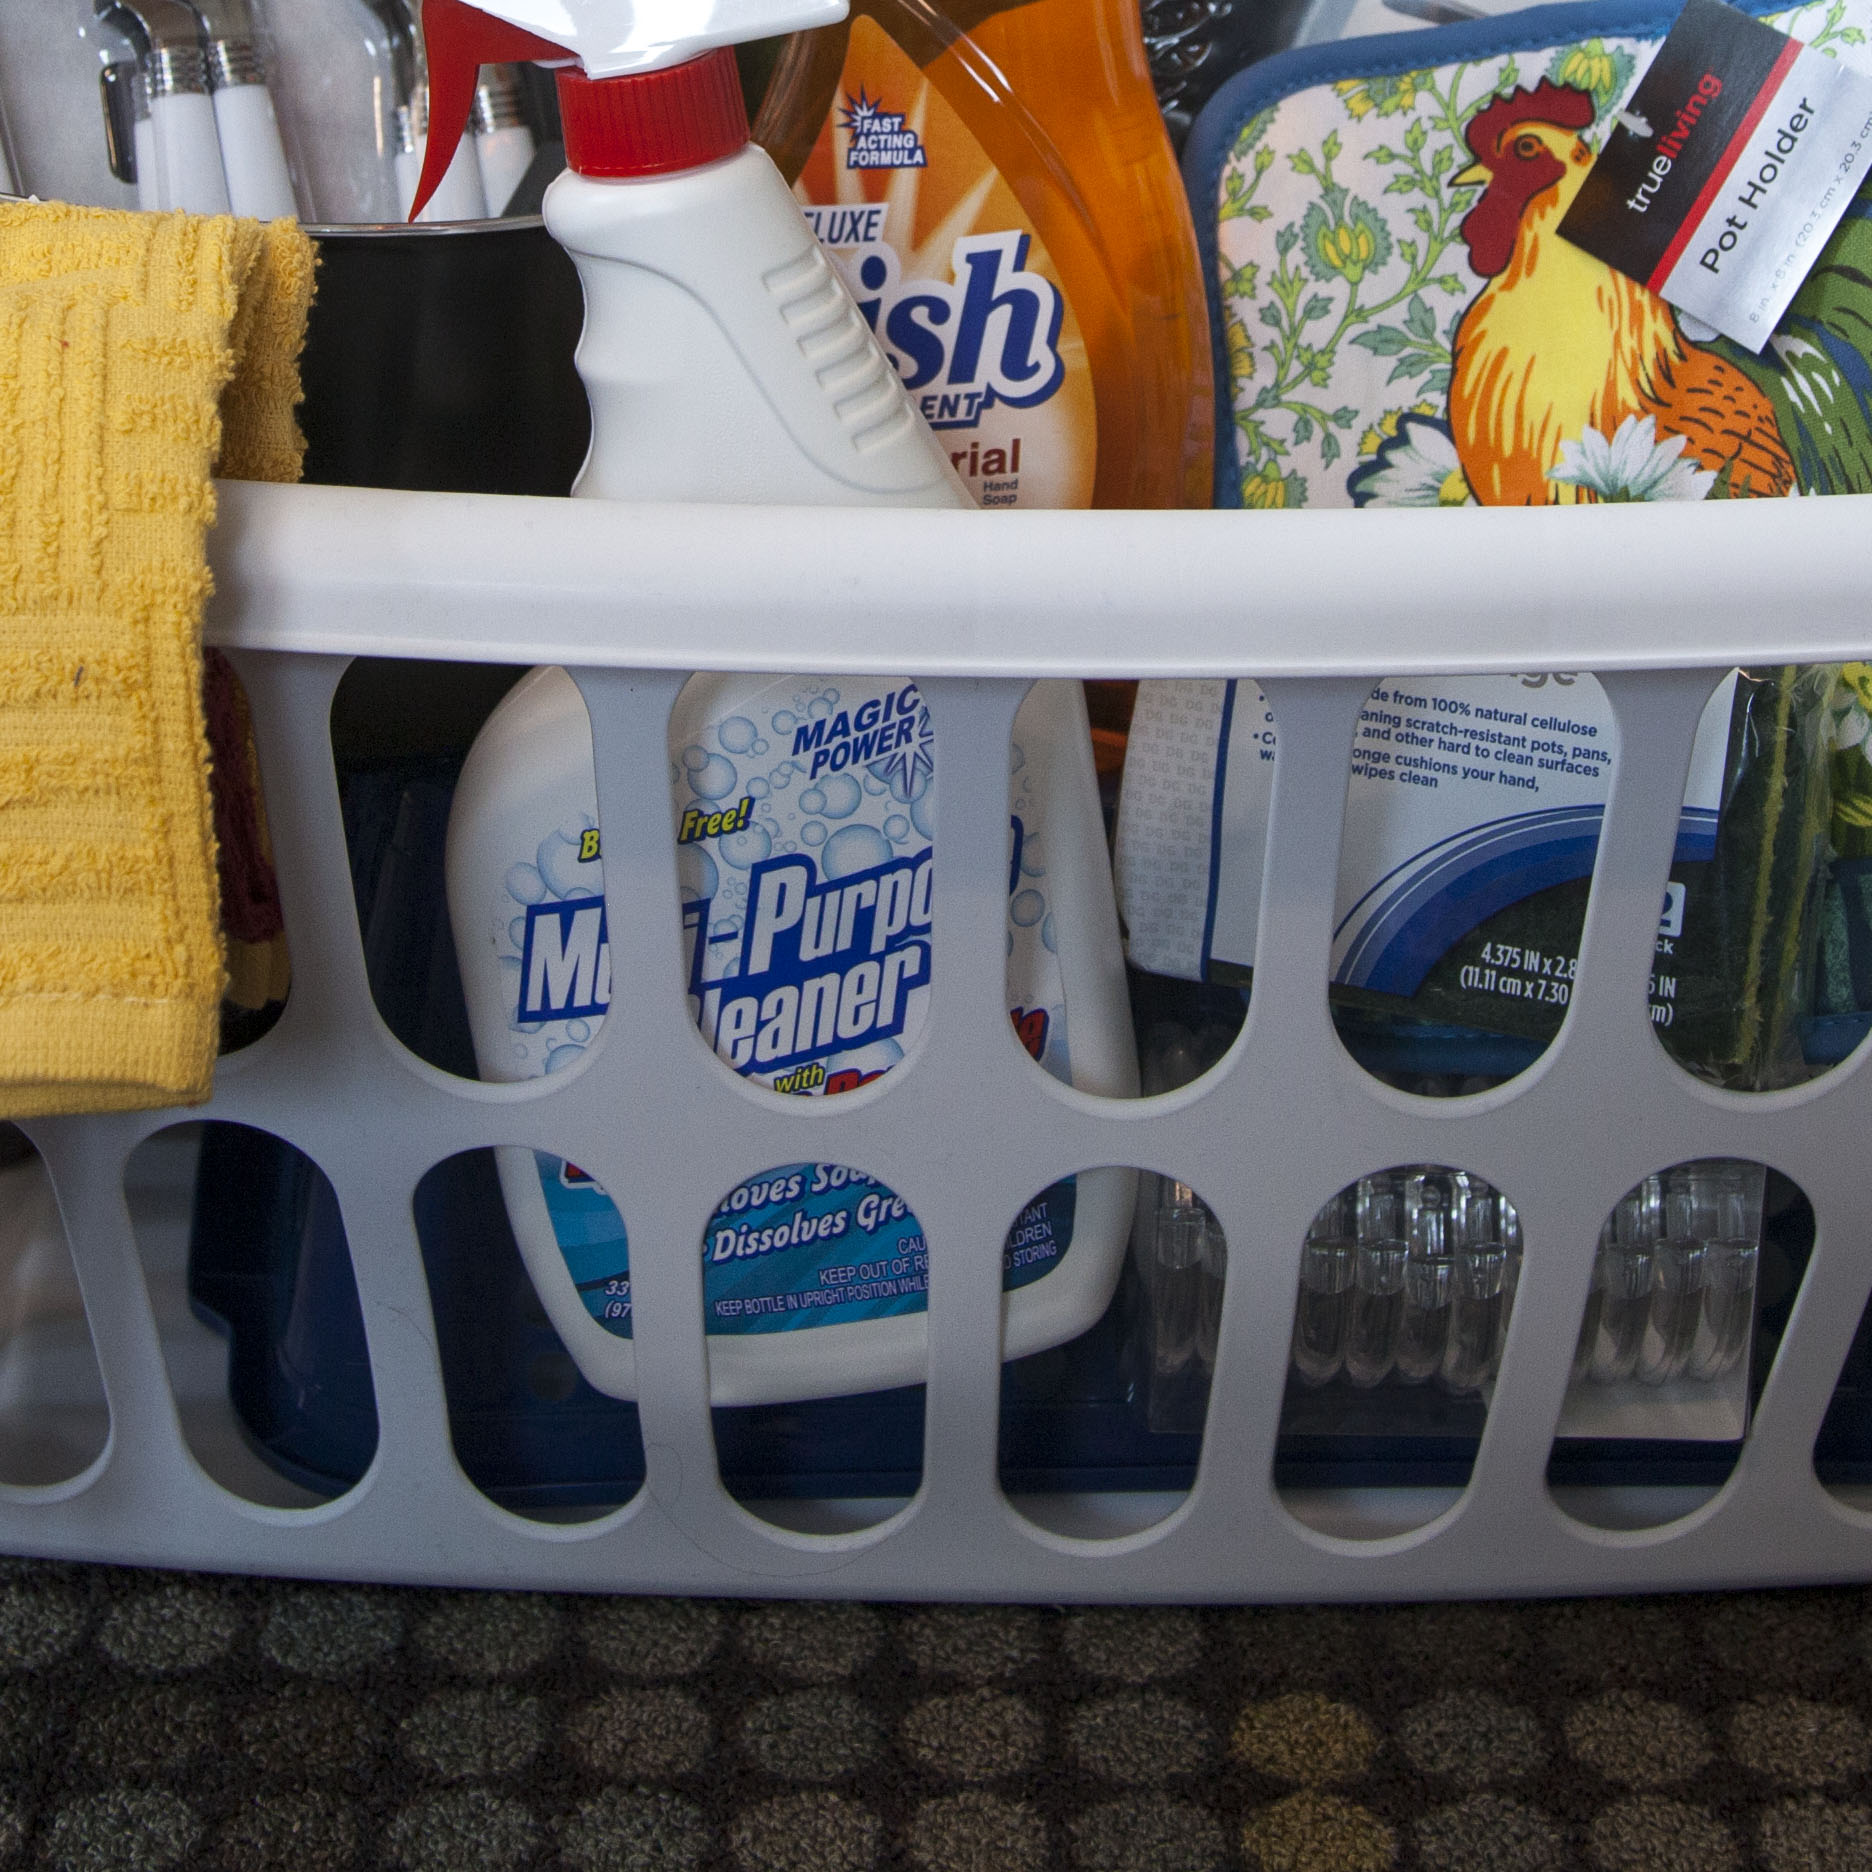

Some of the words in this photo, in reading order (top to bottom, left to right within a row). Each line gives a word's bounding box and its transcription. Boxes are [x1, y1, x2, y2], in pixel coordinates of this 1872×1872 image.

[856, 133, 915, 150] ACTING
[861, 116, 903, 132] FAST
[848, 149, 925, 166] FORMULA
[1820, 187, 1836, 209] cm
[1839, 140, 1862, 174] 20.3
[1699, 213, 1748, 274] Pot
[1738, 96, 1816, 210] Holder
[804, 210, 881, 245] LUXE
[857, 246, 1044, 392] ish
[983, 479, 1019, 493] Hand
[983, 493, 1018, 507] Soap
[791, 683, 920, 757] MAGIC
[1360, 709, 1402, 729] aning
[1405, 715, 1527, 749] scratch-resistant
[1530, 739, 1568, 759] pots,
[1571, 745, 1613, 765] pans,
[1392, 690, 1428, 710] from
[1431, 697, 1472, 717] 100%
[1474, 705, 1528, 727] natural
[1530, 714, 1598, 738] cellulose
[809, 715, 916, 780] POWER
[1352, 747, 1391, 765] onge
[1394, 753, 1459, 776] cushions
[1461, 764, 1496, 784] your
[1498, 769, 1540, 793] hand,
[1362, 724, 1392, 742] and
[1394, 729, 1435, 748] other
[1437, 736, 1472, 756] hard
[1474, 744, 1491, 759] to
[1494, 747, 1534, 767] clean
[1536, 755, 1601, 778] surfaces
[1351, 762, 1396, 781] wipes
[1399, 769, 1439, 789] clean
[680, 798, 754, 842] Free!
[1480, 941, 1522, 968] 4.375
[1523, 950, 1541, 973] IN
[1541, 957, 1552, 974] x
[1658, 976, 1677, 999] IN
[1459, 964, 1497, 991] (11.11
[1498, 976, 1522, 996] cm
[1523, 982, 1534, 999] x
[1648, 1002, 1674, 1027] m)
[775, 1064, 826, 1093] with
[719, 1174, 802, 1211] oves
[712, 1210, 847, 1262] Dissolves
[857, 1193, 915, 1231] Gre
[715, 1298, 744, 1316] KEEP
[745, 1295, 787, 1315] BOTTLE
[786, 1294, 799, 1310] IN
[800, 1288, 847, 1309] UPRIGHT
[847, 1281, 898, 1301] POSITION
[1013, 1239, 1057, 1268] STORING
[818, 1267, 857, 1286] KEEP
[859, 1261, 889, 1280] OUT
[891, 1257, 910, 1275] OF
[604, 1299, 632, 1319] (97
